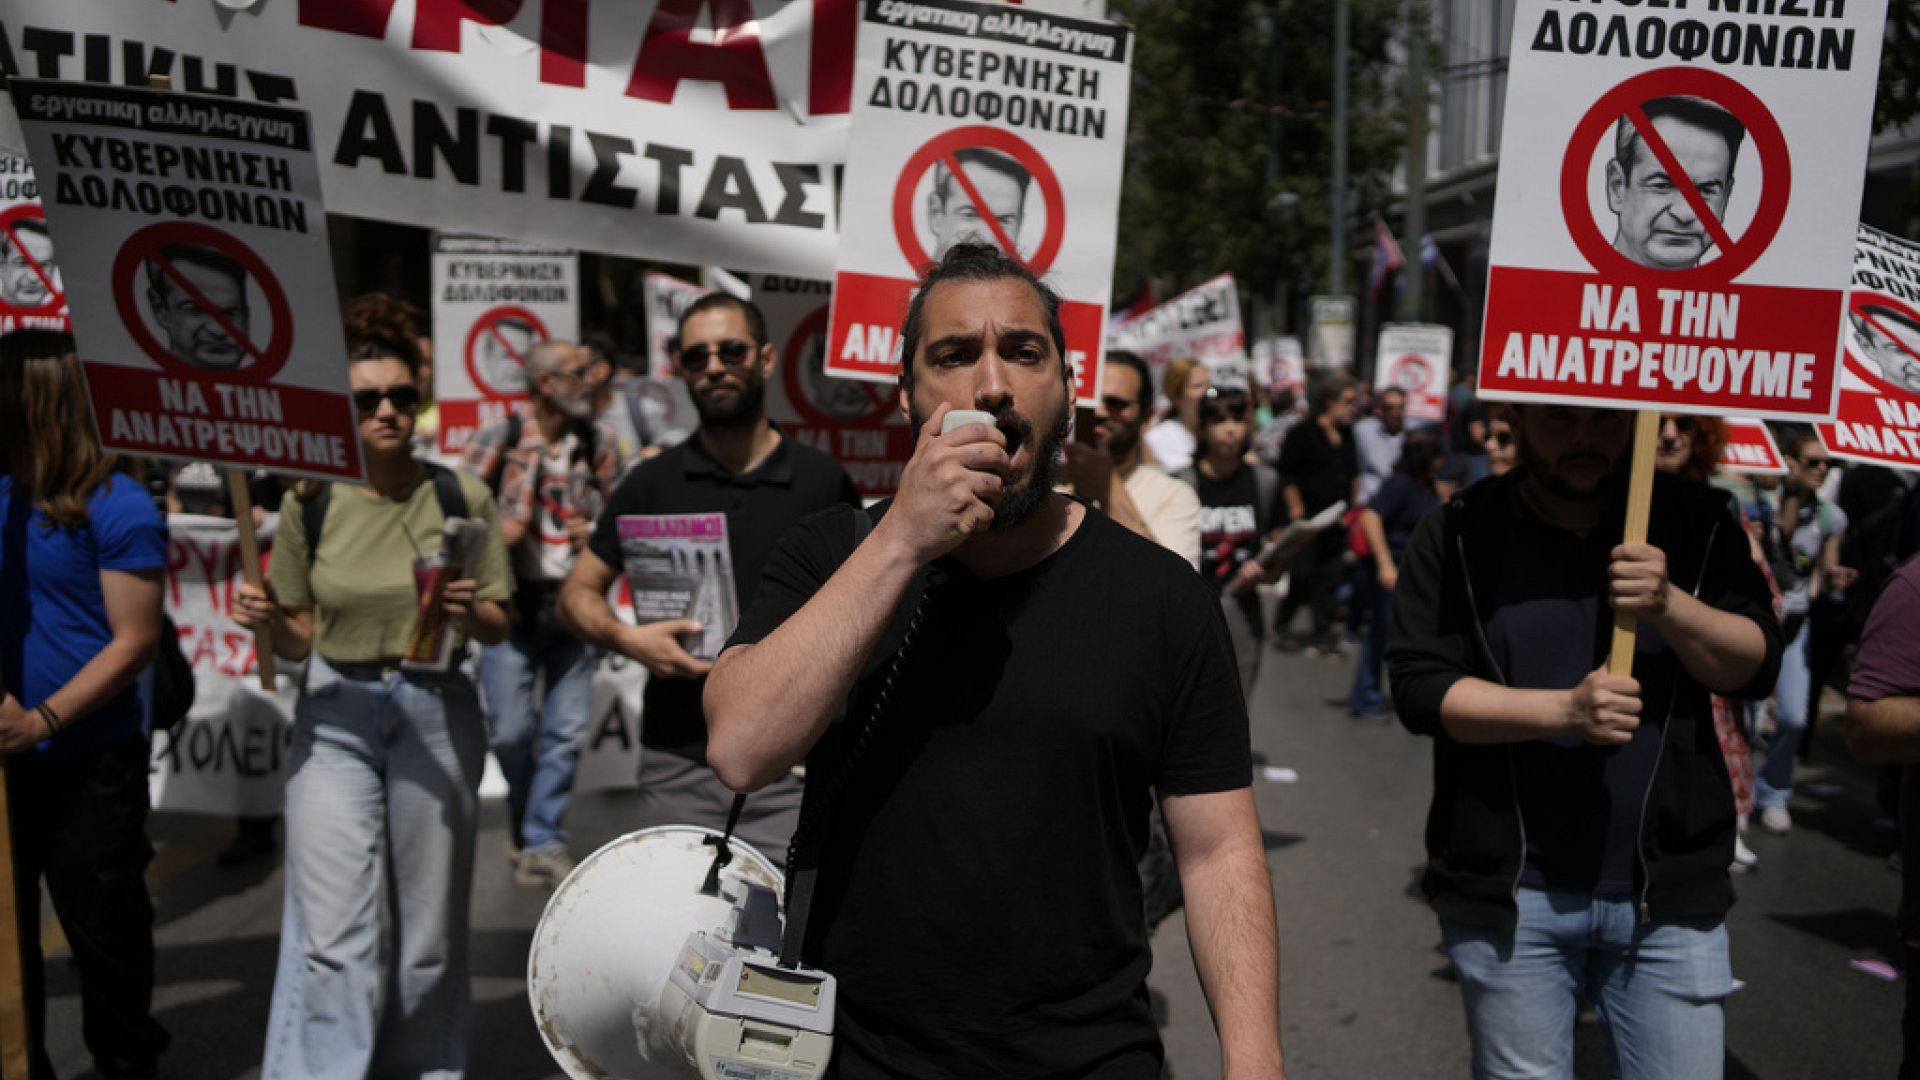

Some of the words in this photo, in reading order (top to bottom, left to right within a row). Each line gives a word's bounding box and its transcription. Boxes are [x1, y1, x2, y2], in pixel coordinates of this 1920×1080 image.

[883, 37, 1100, 100] ΚΥΒΕΡΝΗΣΗ
[1530, 9, 1856, 71] ΔΟΛΟΦΟΝΩΝ
[31, 94, 142, 127] εργατικη
[148, 105, 294, 145] αλληλεγγυη
[868, 76, 1106, 139] ΔΟΛΟΦΟΝΩΝ
[52, 132, 292, 192] ΚΥΒΕΡΝΗΣΗ
[334, 89, 843, 233] ΑΝΤΙΣΤΑΣ
[56, 173, 308, 234] ΔΟΛΟΦΟΝΩΝ
[1579, 283, 1640, 333] ΝΑ
[1657, 289, 1741, 340] ΤΗΝ
[1497, 332, 1816, 400] ΑΝΑΤΡΕΨΟΥΜΕ
[158, 377, 208, 414] ΝΑ
[214, 383, 283, 422] ΤΗΝ
[111, 409, 348, 468] ΑΝΑΤΡΕΨΟΥΜΕ
